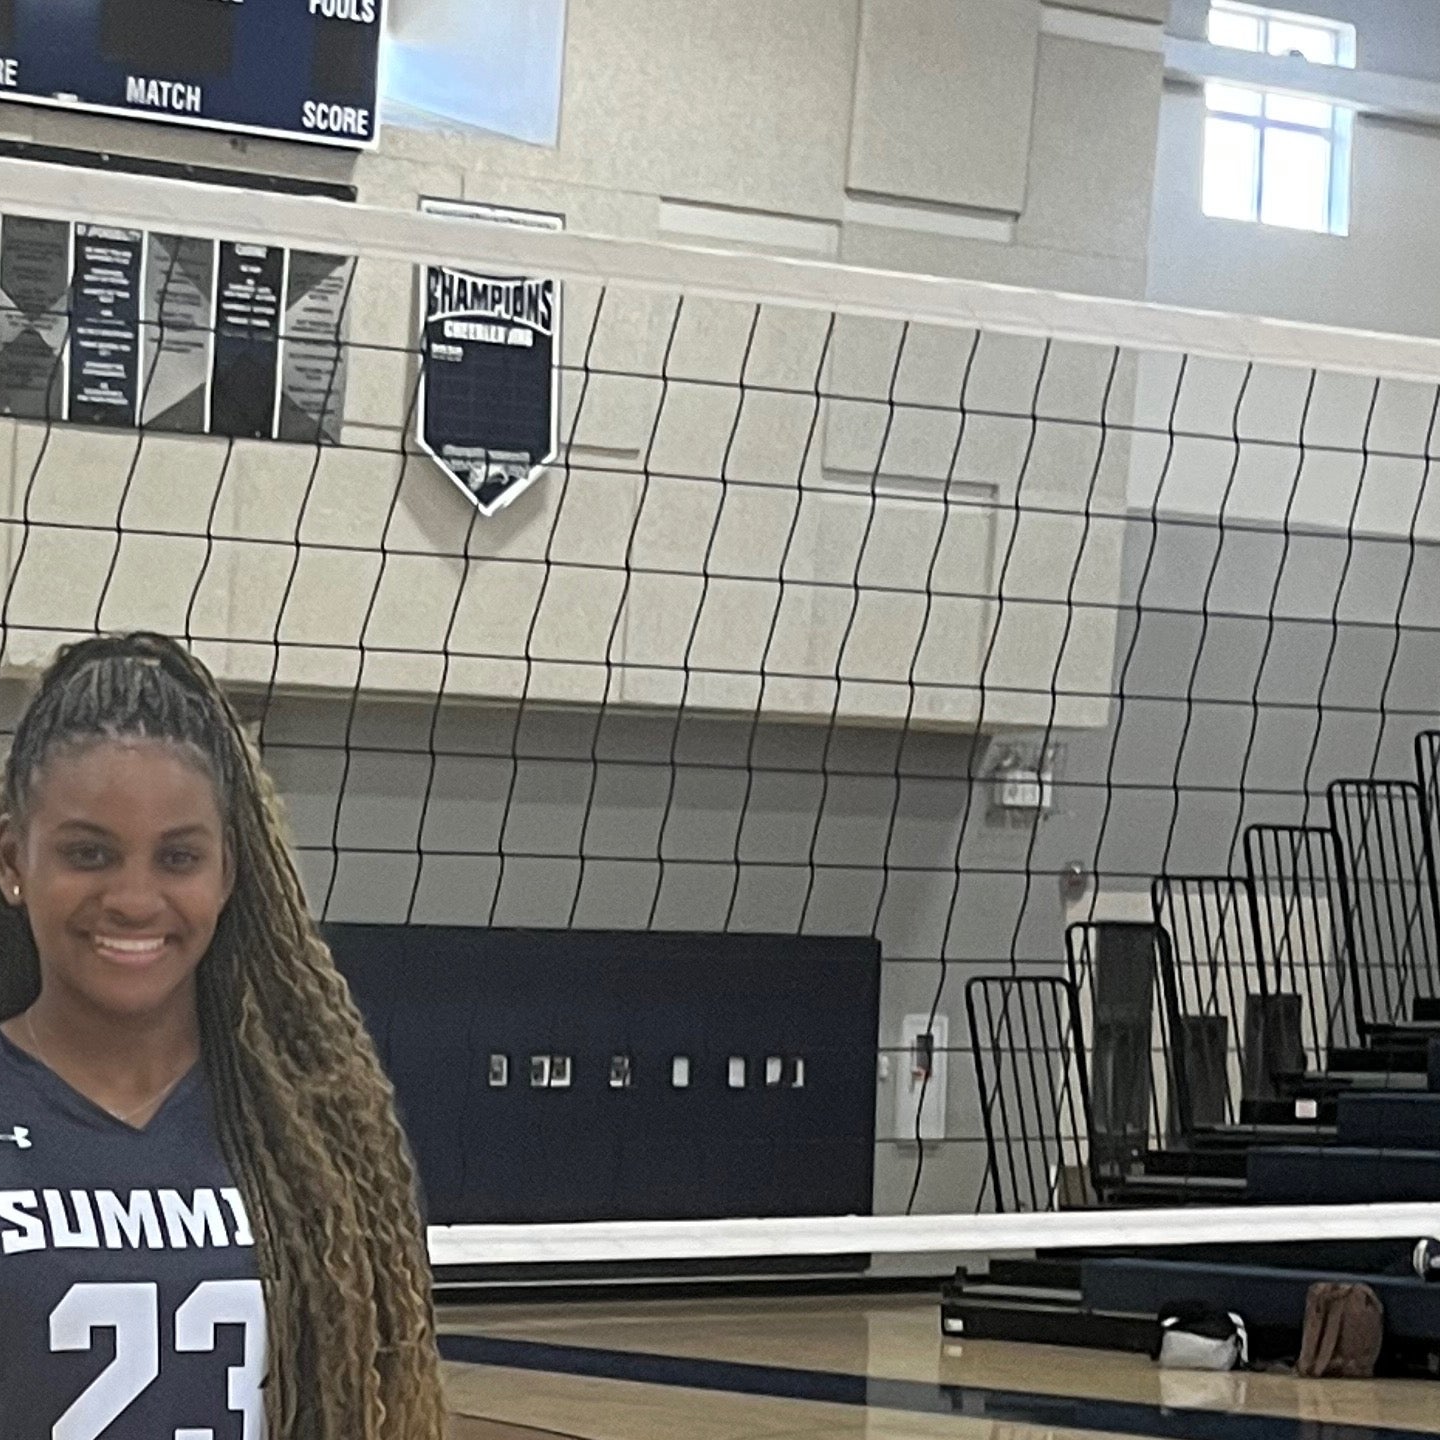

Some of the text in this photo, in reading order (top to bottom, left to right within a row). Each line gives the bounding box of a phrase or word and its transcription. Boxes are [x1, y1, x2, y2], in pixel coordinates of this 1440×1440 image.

[126, 76, 201, 113] MATCH
[302, 101, 369, 136] SCORE
[427, 267, 552, 332] CHAMPIONS
